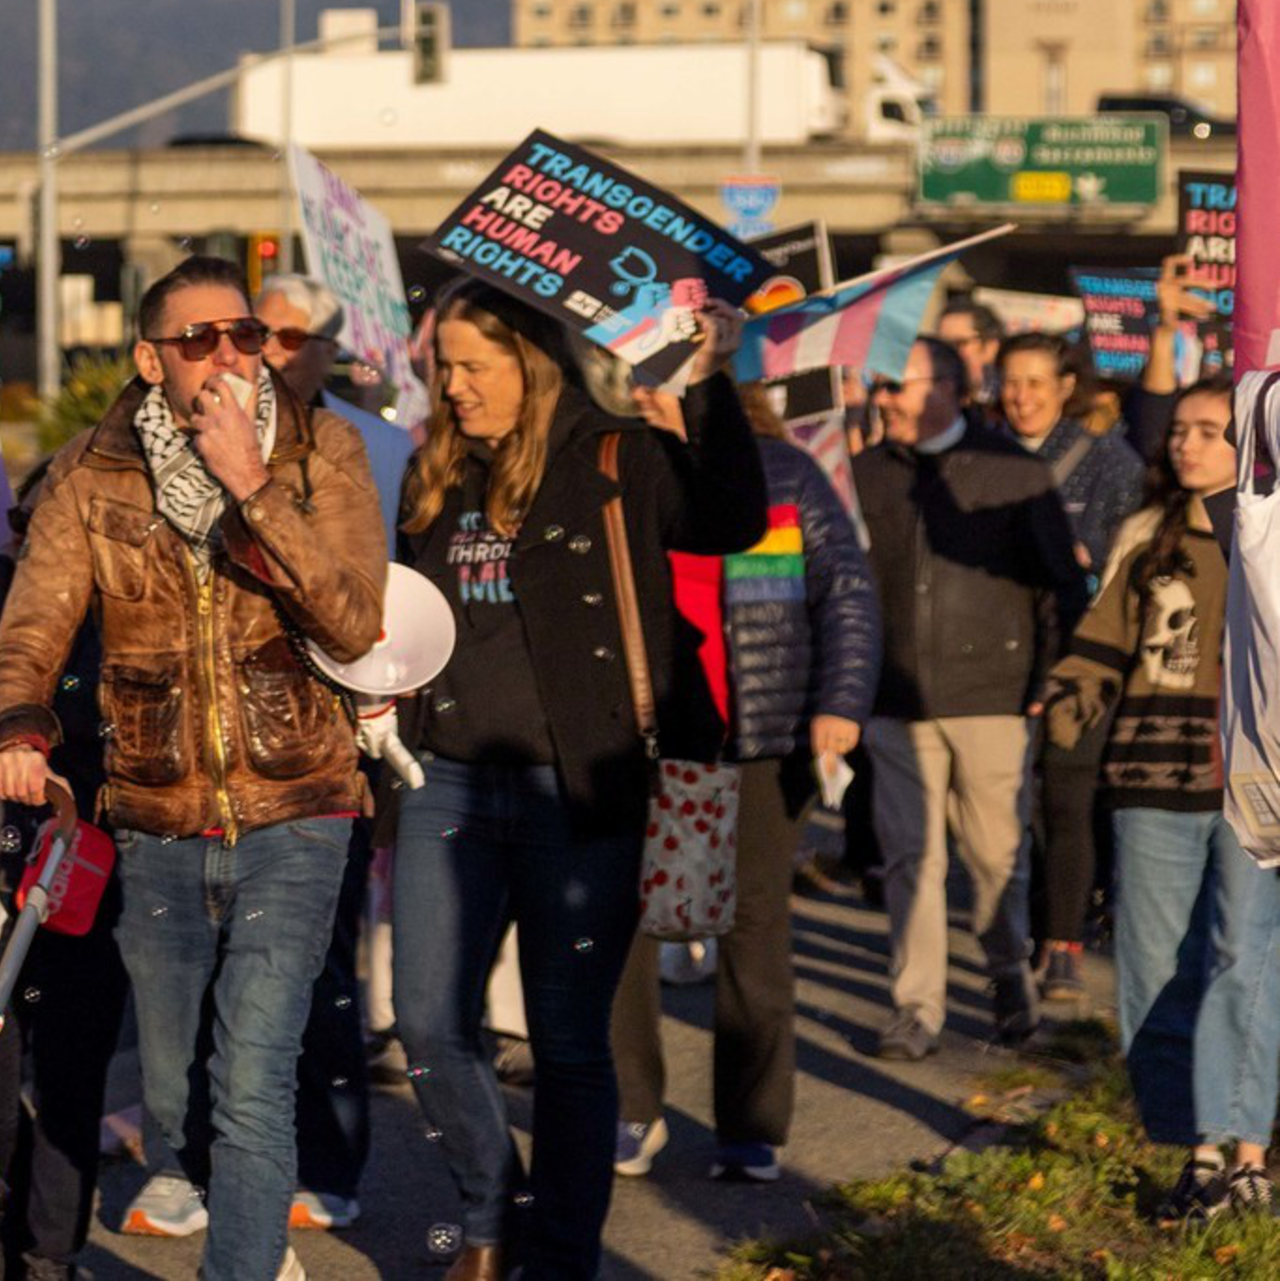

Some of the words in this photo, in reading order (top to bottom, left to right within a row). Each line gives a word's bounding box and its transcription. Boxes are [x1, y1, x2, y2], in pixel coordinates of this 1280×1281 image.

[480, 186, 554, 229] ARE
[501, 164, 625, 235] RIGHTS
[526, 143, 755, 283] TRANSGENDER
[1185, 209, 1237, 236] RIG
[440, 226, 564, 297] RIGHTS
[462, 206, 582, 276] HUMAN
